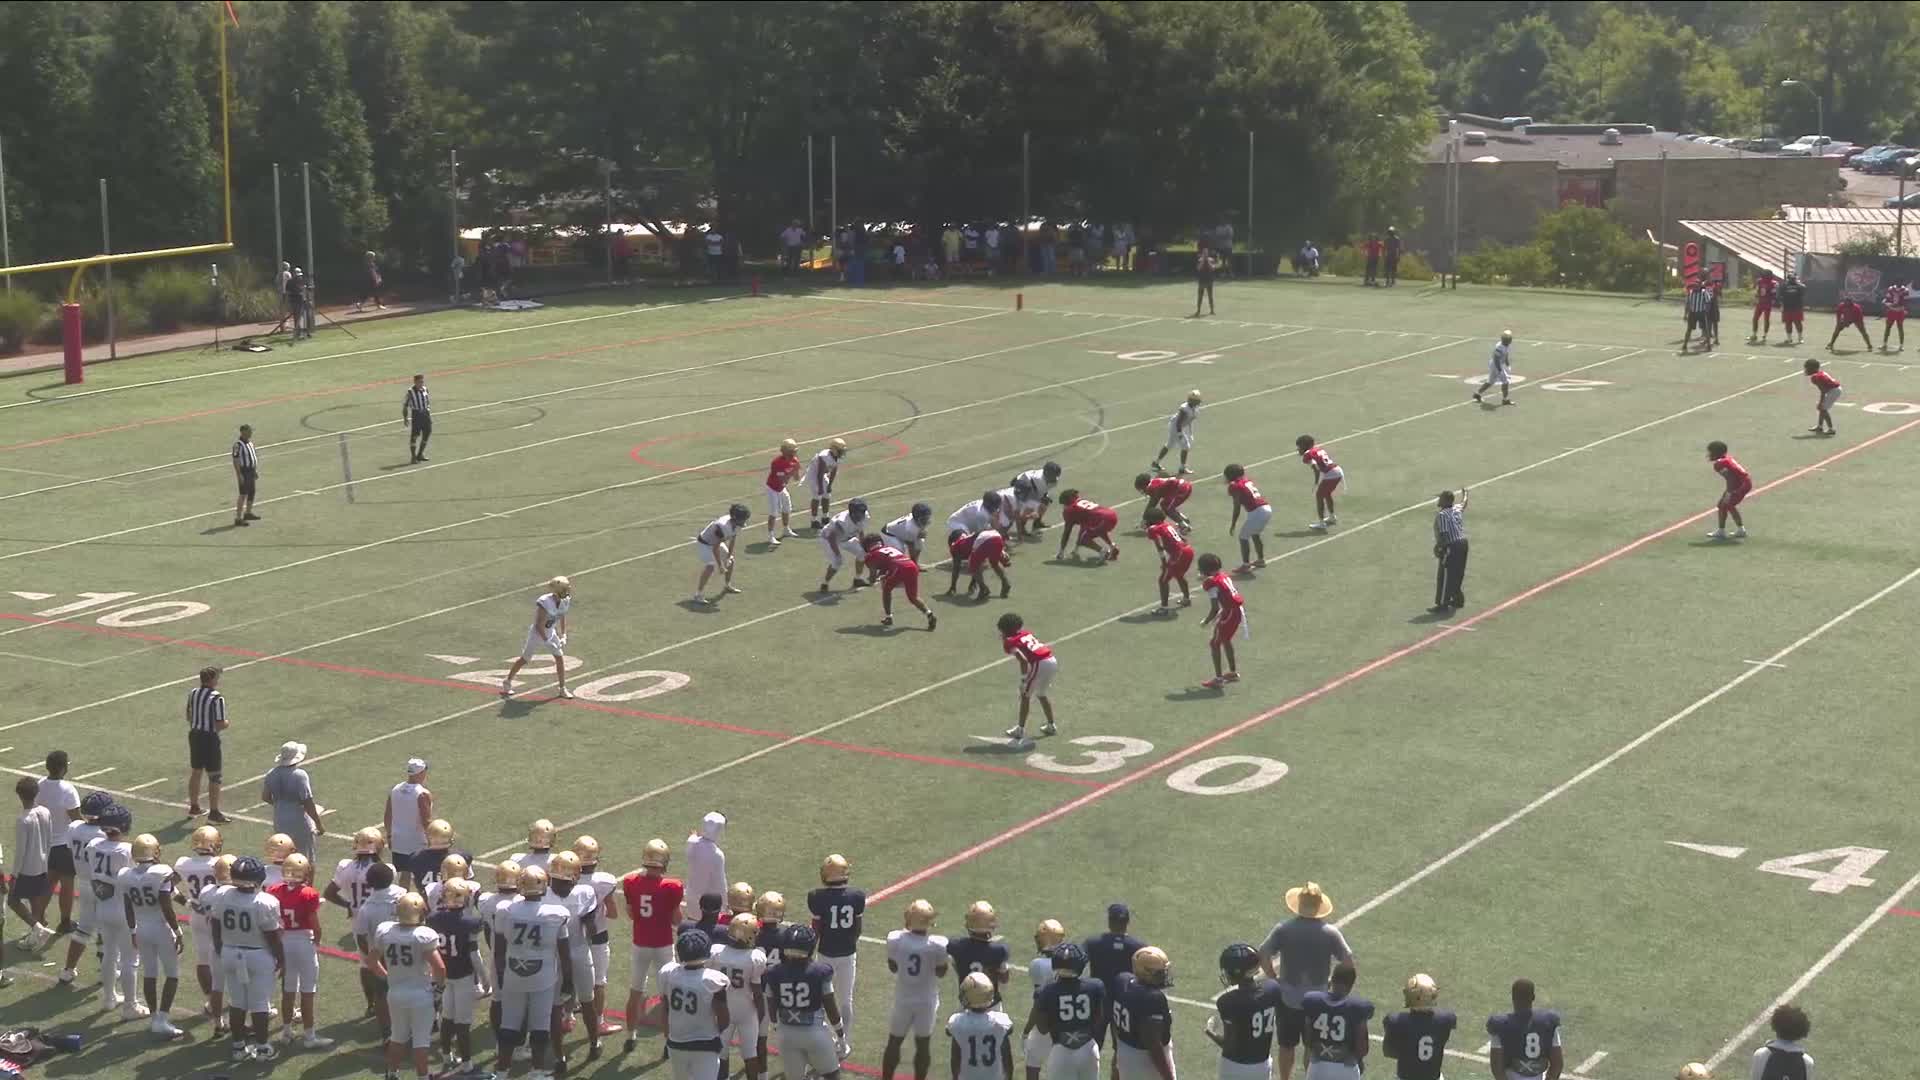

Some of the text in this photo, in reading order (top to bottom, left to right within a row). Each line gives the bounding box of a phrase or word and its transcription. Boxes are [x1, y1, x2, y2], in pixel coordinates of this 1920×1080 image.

[36, 591, 211, 627] 10
[1026, 735, 1289, 795] 30
[72, 839, 89, 863] 7
[94, 852, 113, 876] 71
[421, 870, 441, 886] 4
[128, 886, 157, 907] 85
[639, 894, 654, 918] 5
[223, 908, 252, 933] 60
[829, 905, 855, 929] 13
[513, 922, 542, 947] 74
[387, 943, 414, 967] 45
[908, 953, 922, 977] 3
[670, 987, 699, 1016] 63
[779, 982, 811, 1009] 52
[1058, 994, 1091, 1022] 53
[1113, 1000, 1131, 1033] 53
[1252, 1007, 1276, 1039] 97
[1313, 1012, 1346, 1042] 43
[968, 1034, 997, 1067] 13
[1417, 1035, 1434, 1062] 6
[1525, 1031, 1541, 1059] 8
